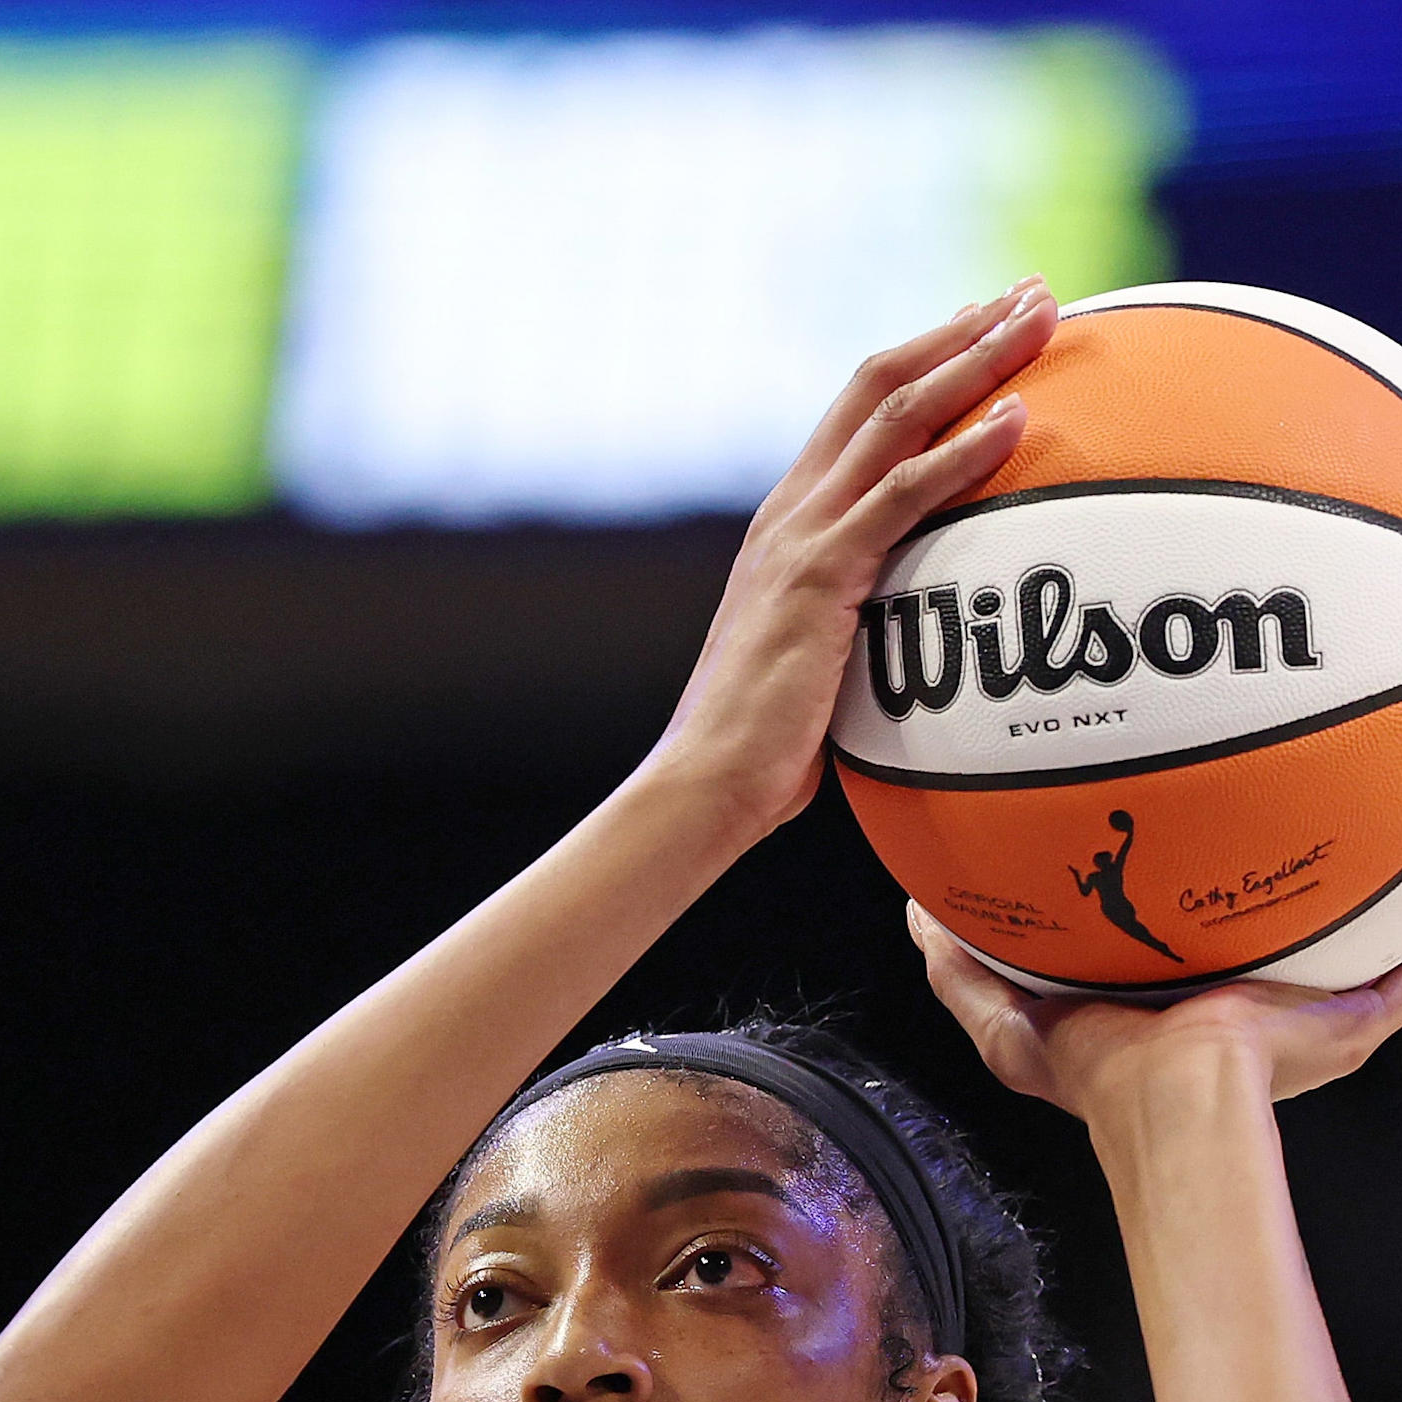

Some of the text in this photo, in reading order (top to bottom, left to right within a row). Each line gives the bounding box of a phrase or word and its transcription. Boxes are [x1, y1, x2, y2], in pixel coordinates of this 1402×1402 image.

[859, 563, 1323, 722] Wilson
[1009, 709, 1128, 737] EVO NXT
